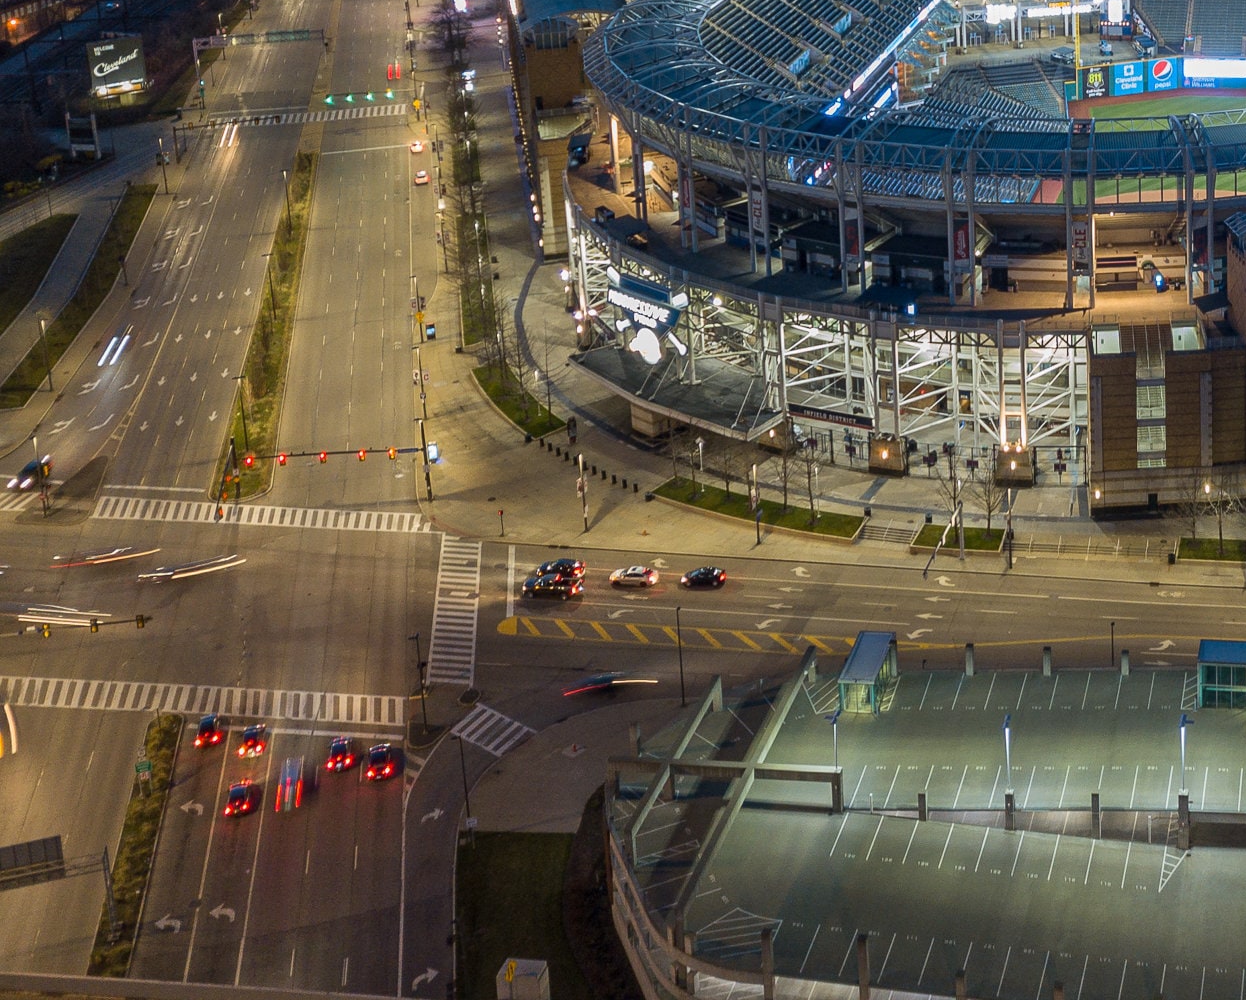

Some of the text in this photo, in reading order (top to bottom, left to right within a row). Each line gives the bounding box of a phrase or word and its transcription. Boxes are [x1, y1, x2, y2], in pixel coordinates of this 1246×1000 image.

[93, 48, 139, 77] Cleveland
[1088, 72, 1101, 83] 811
[1115, 75, 1143, 84] Cleveland
[1154, 81, 1171, 89] pepsi
[803, 409, 856, 424] INFIELD DISTRICT
